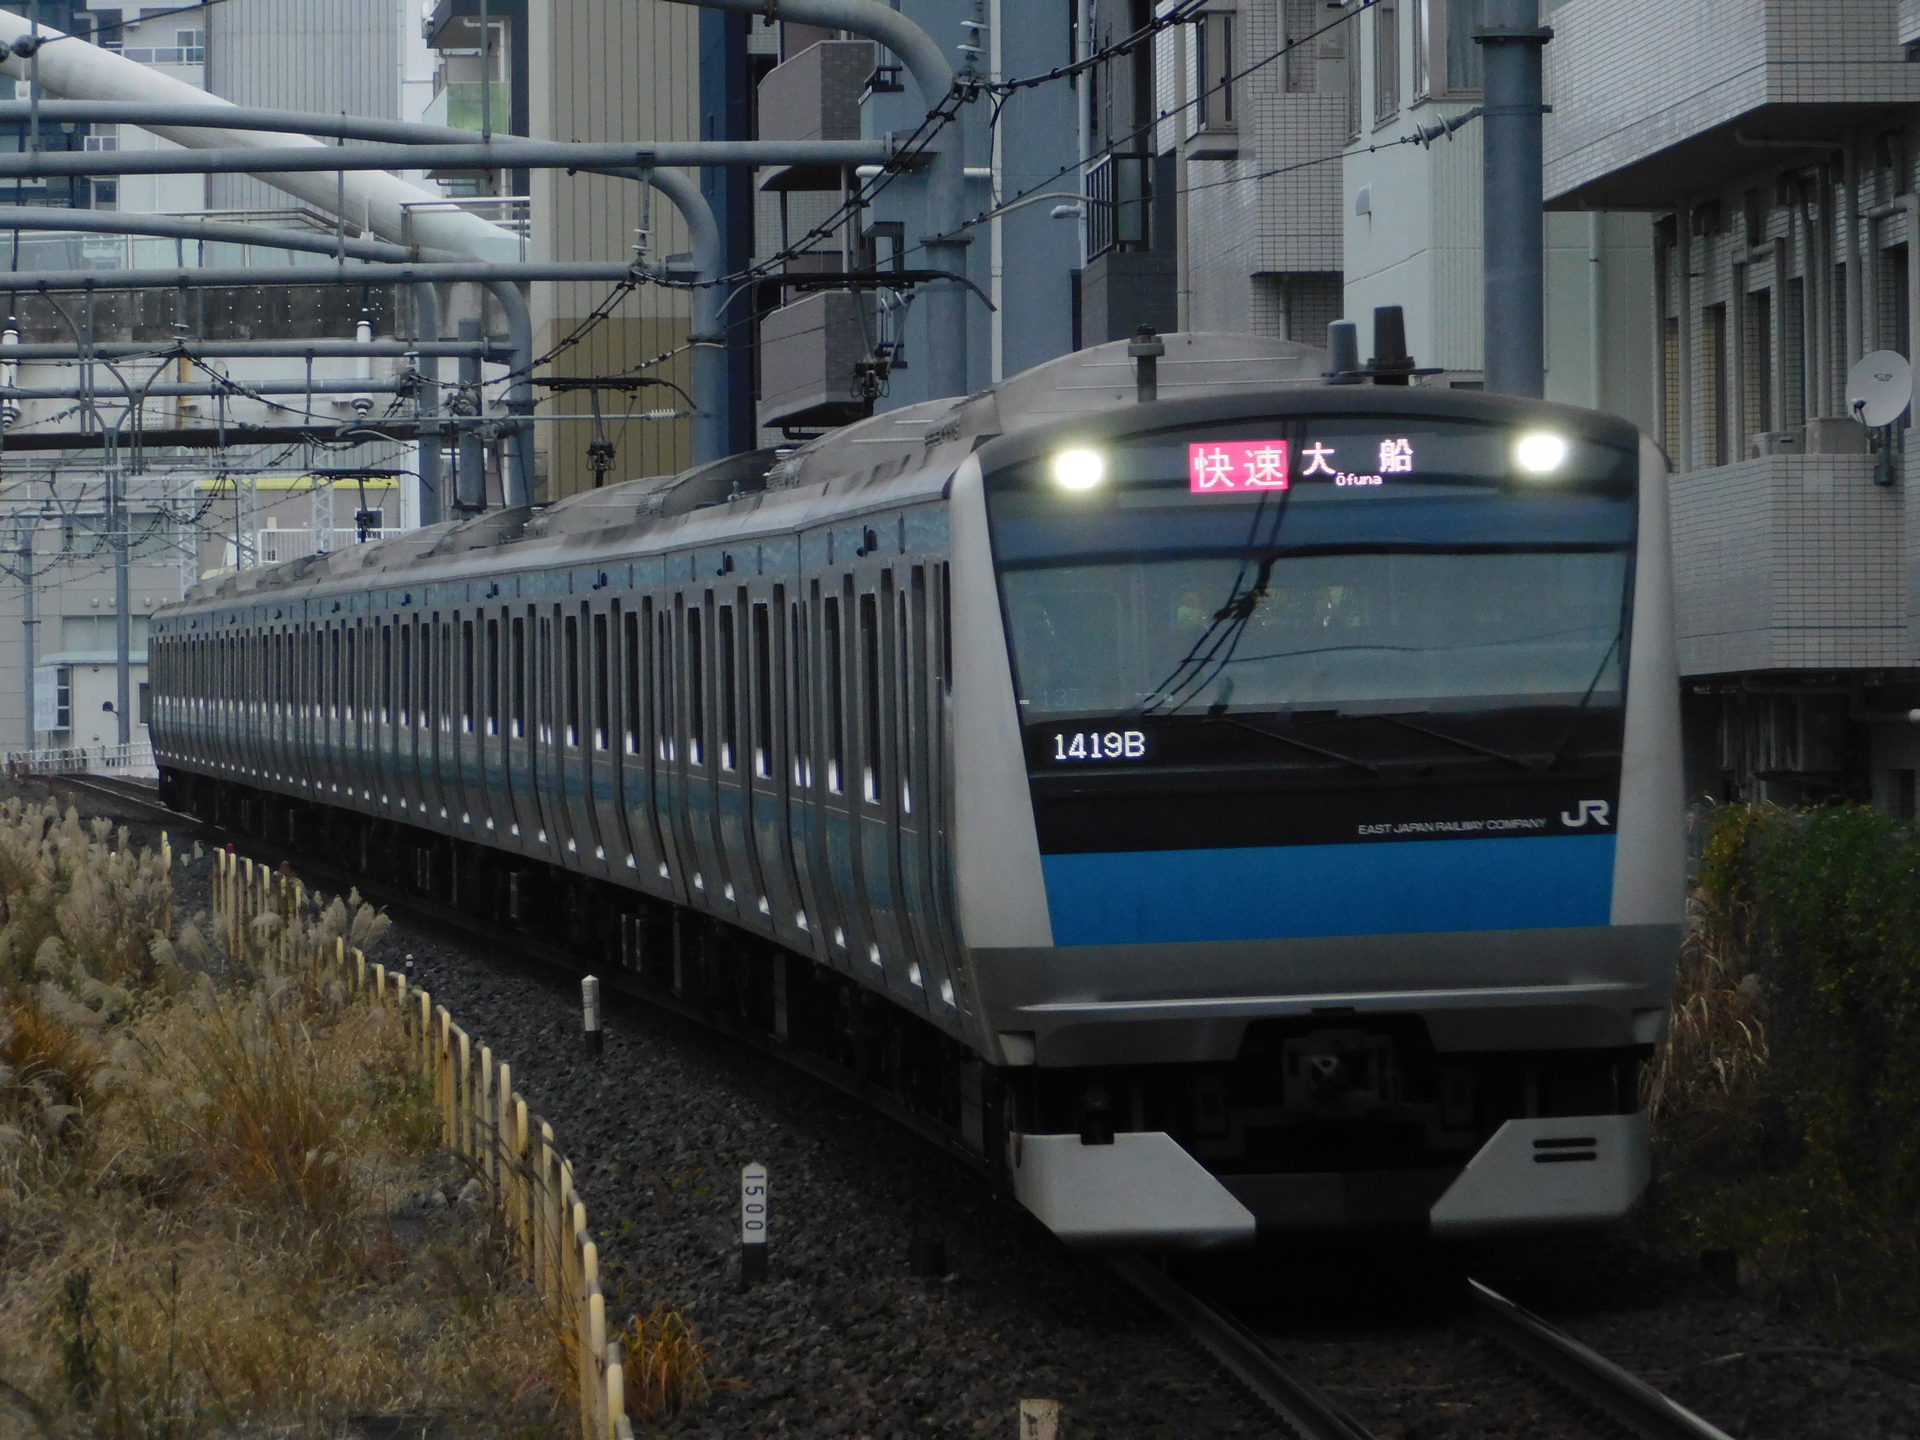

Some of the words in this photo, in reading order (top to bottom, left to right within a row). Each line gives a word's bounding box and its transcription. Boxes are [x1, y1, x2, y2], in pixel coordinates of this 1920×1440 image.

[1194, 445, 1284, 487] 快速
[1302, 439, 1413, 475] 大船
[1336, 472, 1382, 486] Ōfuna
[1055, 731, 1145, 760] 1419B
[1358, 823, 1392, 835] EAST
[1393, 822, 1434, 833] JAPAN
[1435, 820, 1484, 831] RAILWAY
[1486, 818, 1546, 830] COMPANY
[1561, 799, 1610, 828] JR
[745, 1174, 764, 1231] 1500
